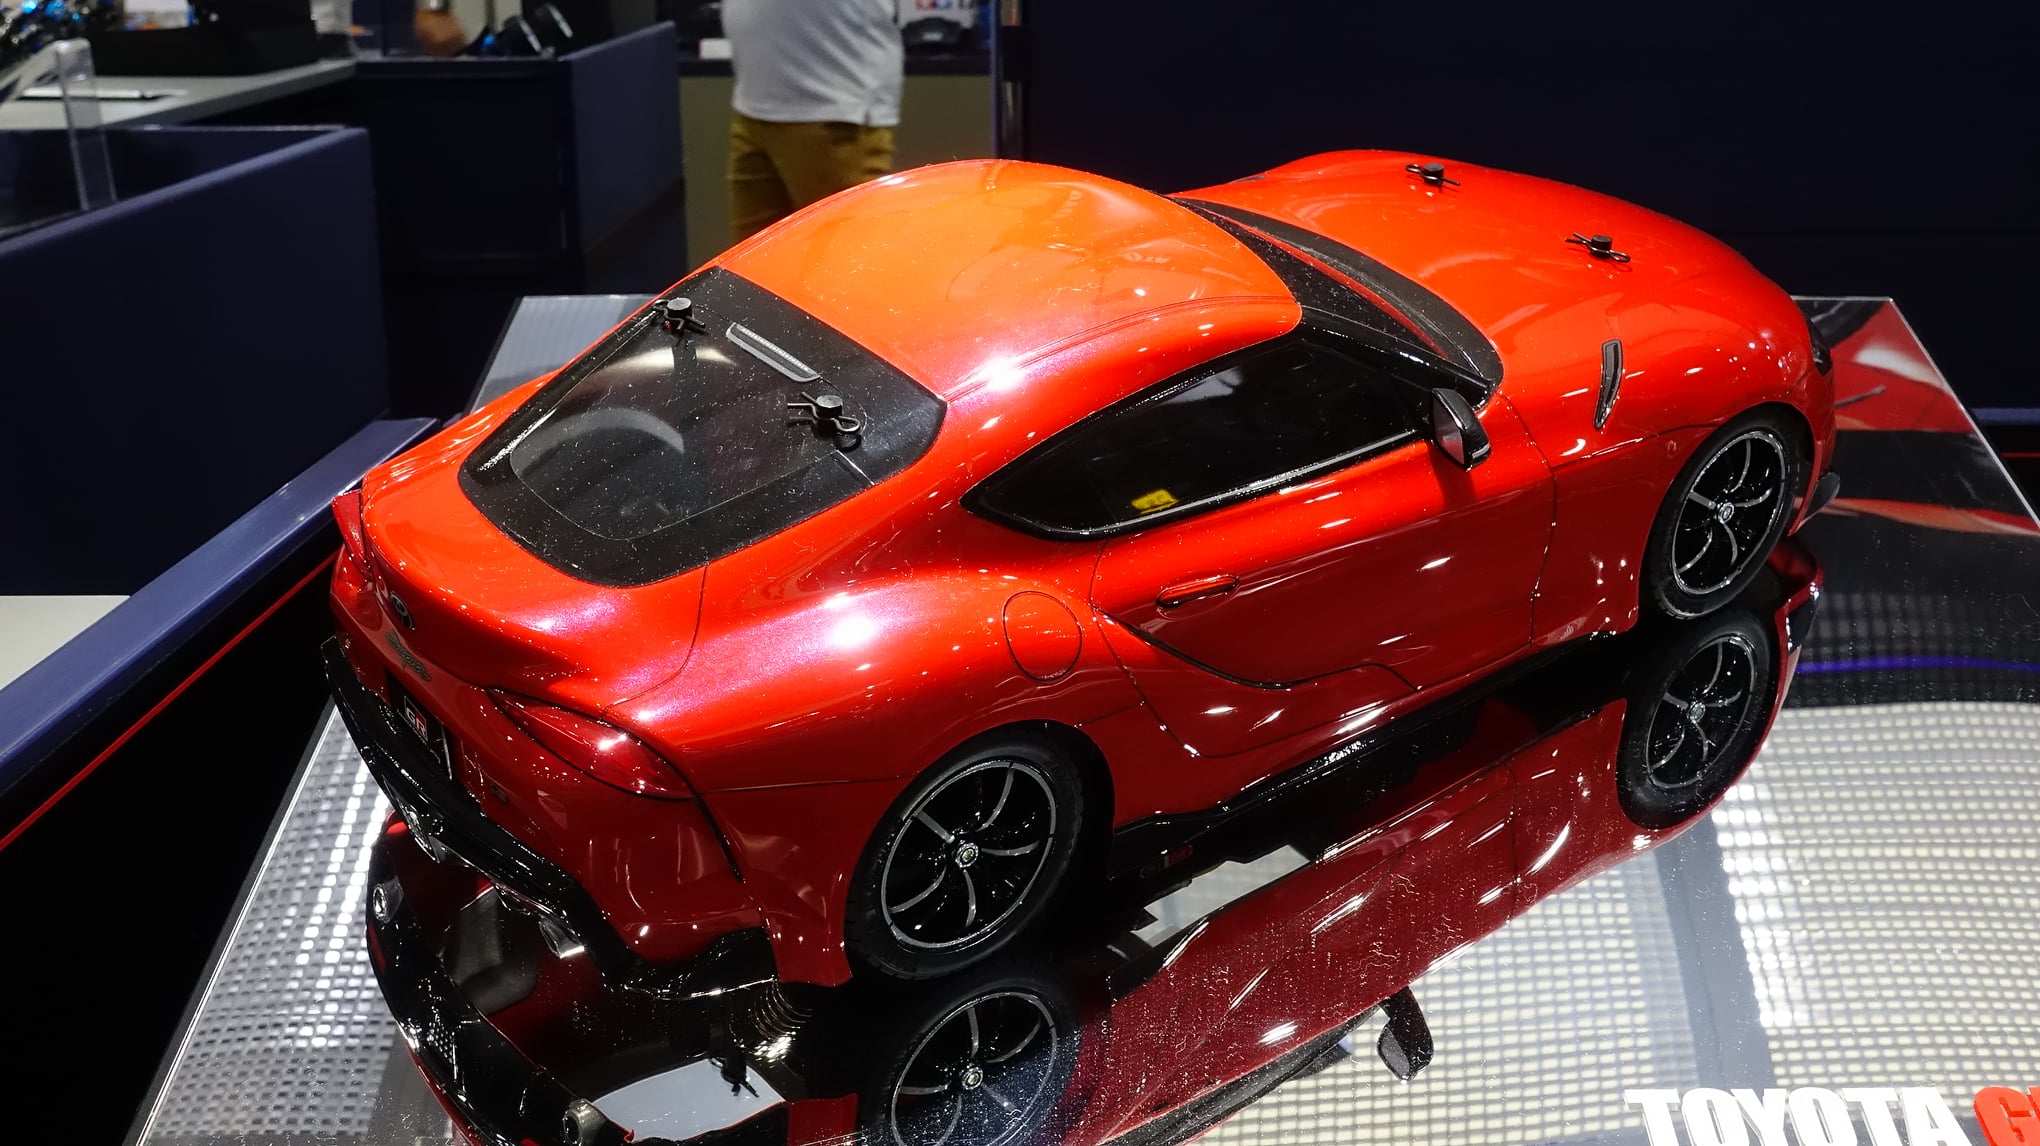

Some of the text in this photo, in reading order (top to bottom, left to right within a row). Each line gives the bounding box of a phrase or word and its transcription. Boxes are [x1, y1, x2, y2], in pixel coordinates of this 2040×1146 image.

[405, 706, 426, 739] GR
[1625, 1086, 2040, 1146] TOYOTA G
